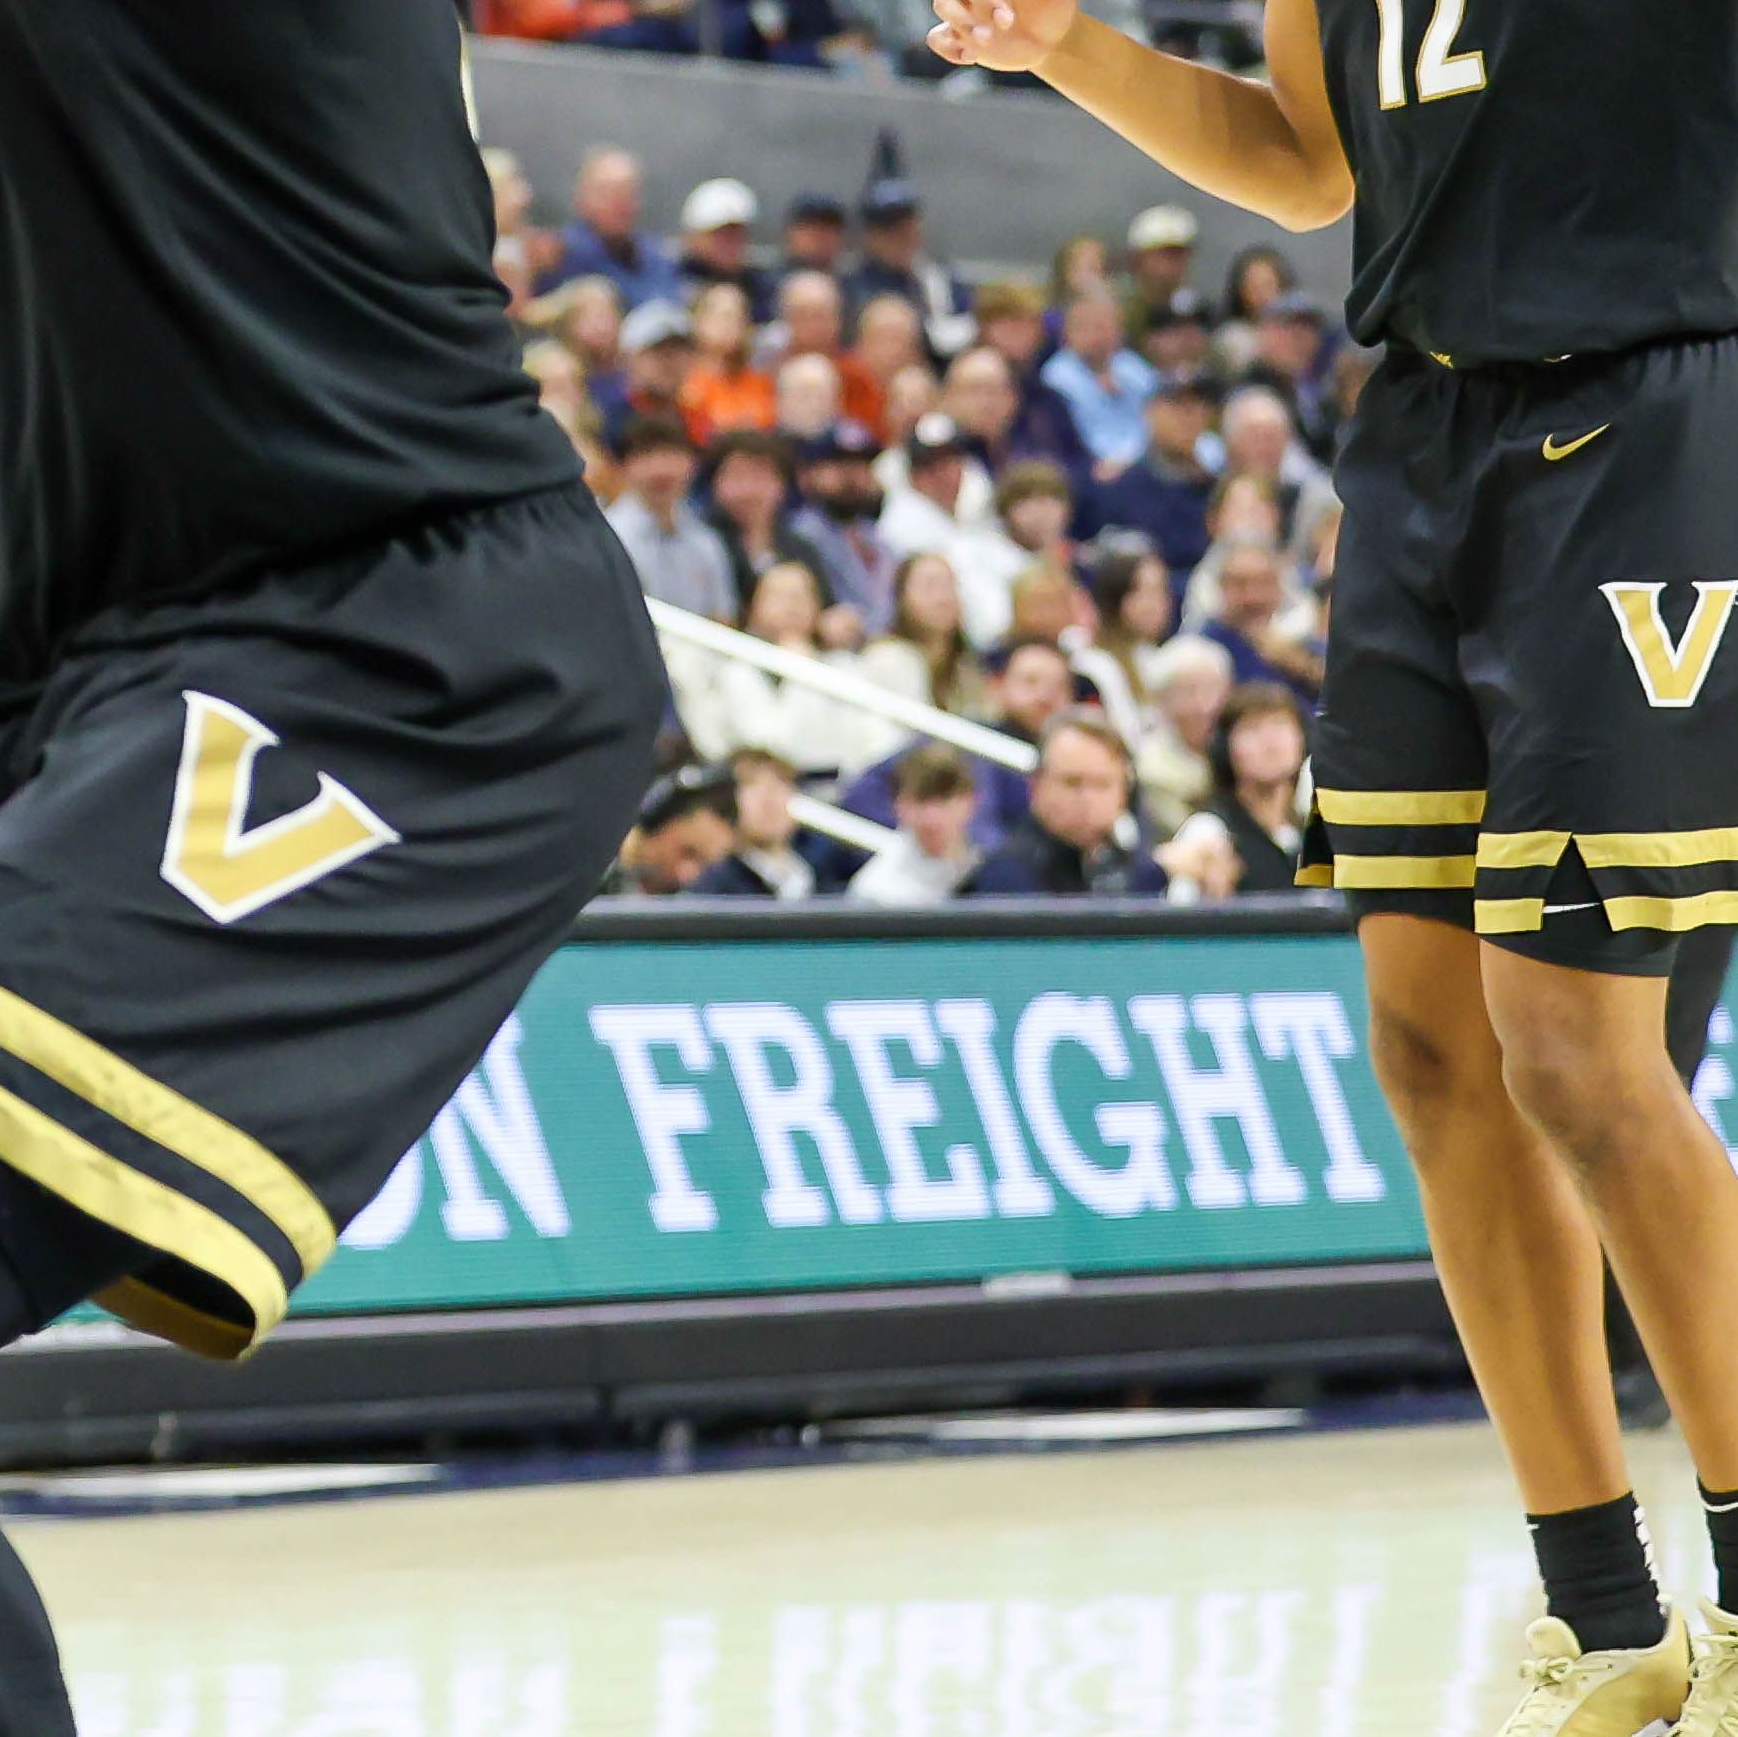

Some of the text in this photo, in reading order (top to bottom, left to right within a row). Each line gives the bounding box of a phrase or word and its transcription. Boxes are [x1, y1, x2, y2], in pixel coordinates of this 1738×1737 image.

[1598, 580, 1737, 708] V
[160, 689, 402, 925] V
[588, 990, 1389, 1232] FREIGHT
